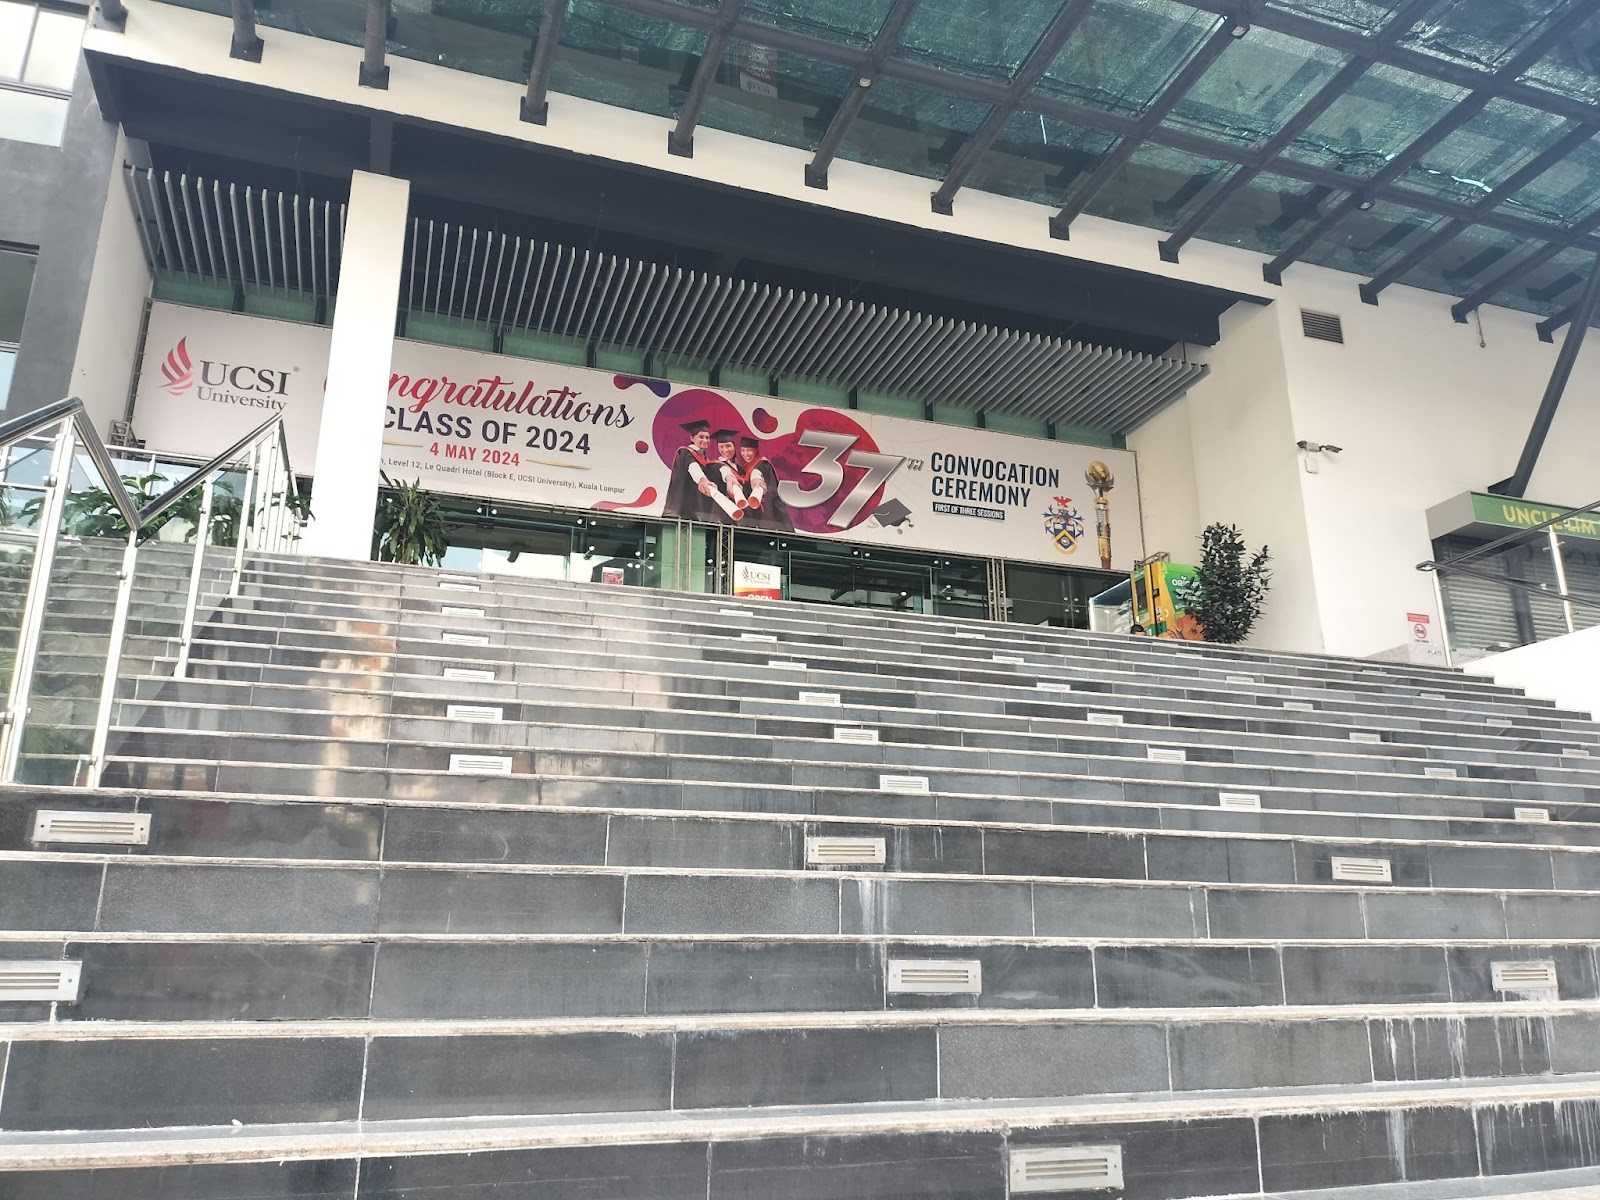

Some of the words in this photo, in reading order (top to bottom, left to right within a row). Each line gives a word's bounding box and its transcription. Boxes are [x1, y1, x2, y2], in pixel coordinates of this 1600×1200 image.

[199, 360, 290, 396] UCSI
[196, 386, 287, 412] University
[324, 373, 635, 429] ngratulations
[429, 442, 440, 457] 4
[444, 443, 477, 461] MAY
[481, 449, 521, 467] 2024
[481, 419, 518, 446] OF
[525, 425, 591, 456] 2024
[388, 458, 409, 467] Level
[412, 461, 423, 470] 12,
[436, 464, 461, 473] Quadri
[462, 467, 483, 476] Hotel
[484, 470, 507, 480] (Block
[517, 474, 535, 483] UCSI
[578, 481, 599, 491] Kuala
[599, 484, 626, 494] Lumpur
[930, 451, 1060, 489] CONVOCATION
[931, 475, 1031, 508] CEREMONY
[935, 503, 951, 513] FIRST
[950, 505, 960, 514] OF
[959, 506, 977, 516] THREE
[976, 508, 1004, 519] SESSIONS
[750, 571, 771, 582] UCSI
